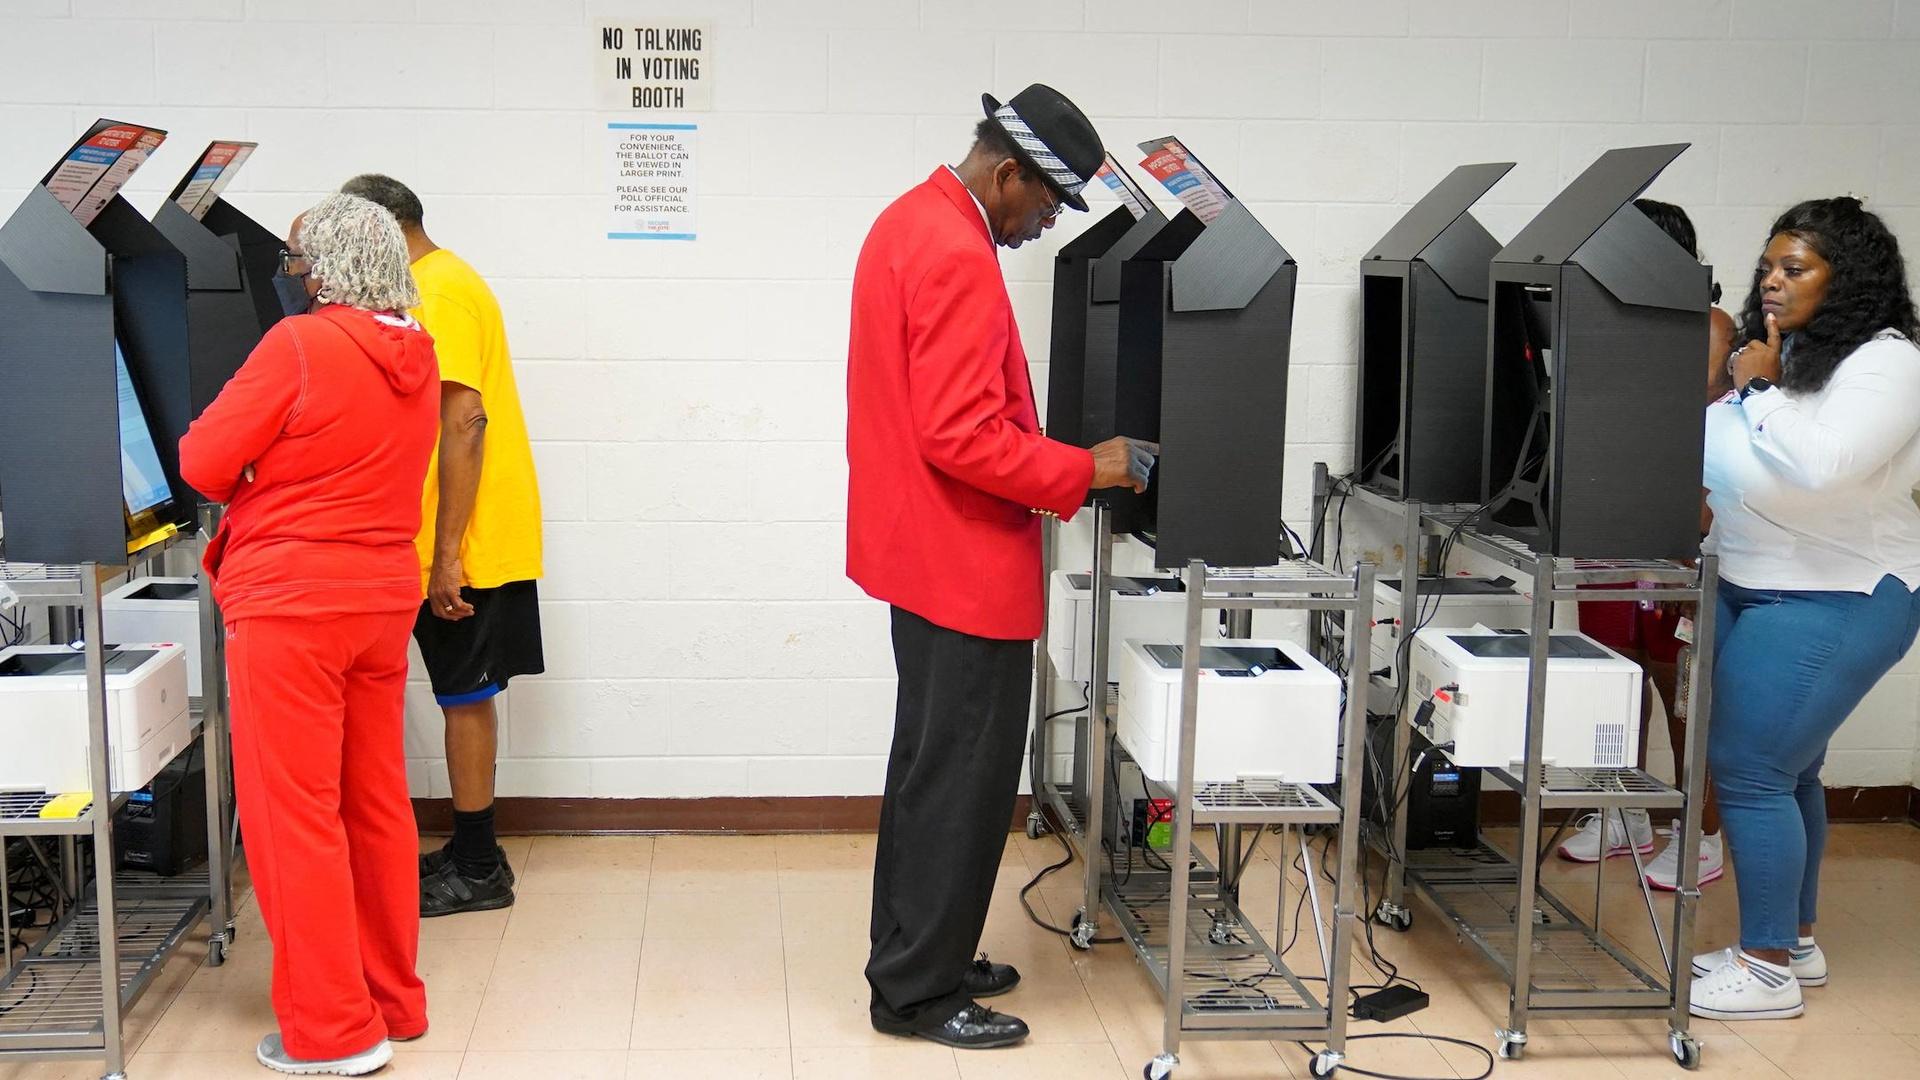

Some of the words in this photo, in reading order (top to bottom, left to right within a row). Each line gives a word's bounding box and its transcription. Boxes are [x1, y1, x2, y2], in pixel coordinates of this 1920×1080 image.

[602, 27, 623, 50] NO
[634, 28, 702, 51] TALKING
[616, 57, 631, 79] IN
[642, 57, 699, 80] VOTING
[632, 86, 684, 108] BOOTH
[630, 134, 648, 142] FOR
[650, 134, 675, 142] YOUR
[672, 161, 681, 169] IN
[616, 185, 649, 193] PLEASE
[668, 186, 688, 194] OUR
[620, 194, 642, 202] POLL
[644, 194, 683, 202] OFFICIAL
[614, 204, 632, 212] FOR
[634, 205, 690, 213] ASSISTANCE.
